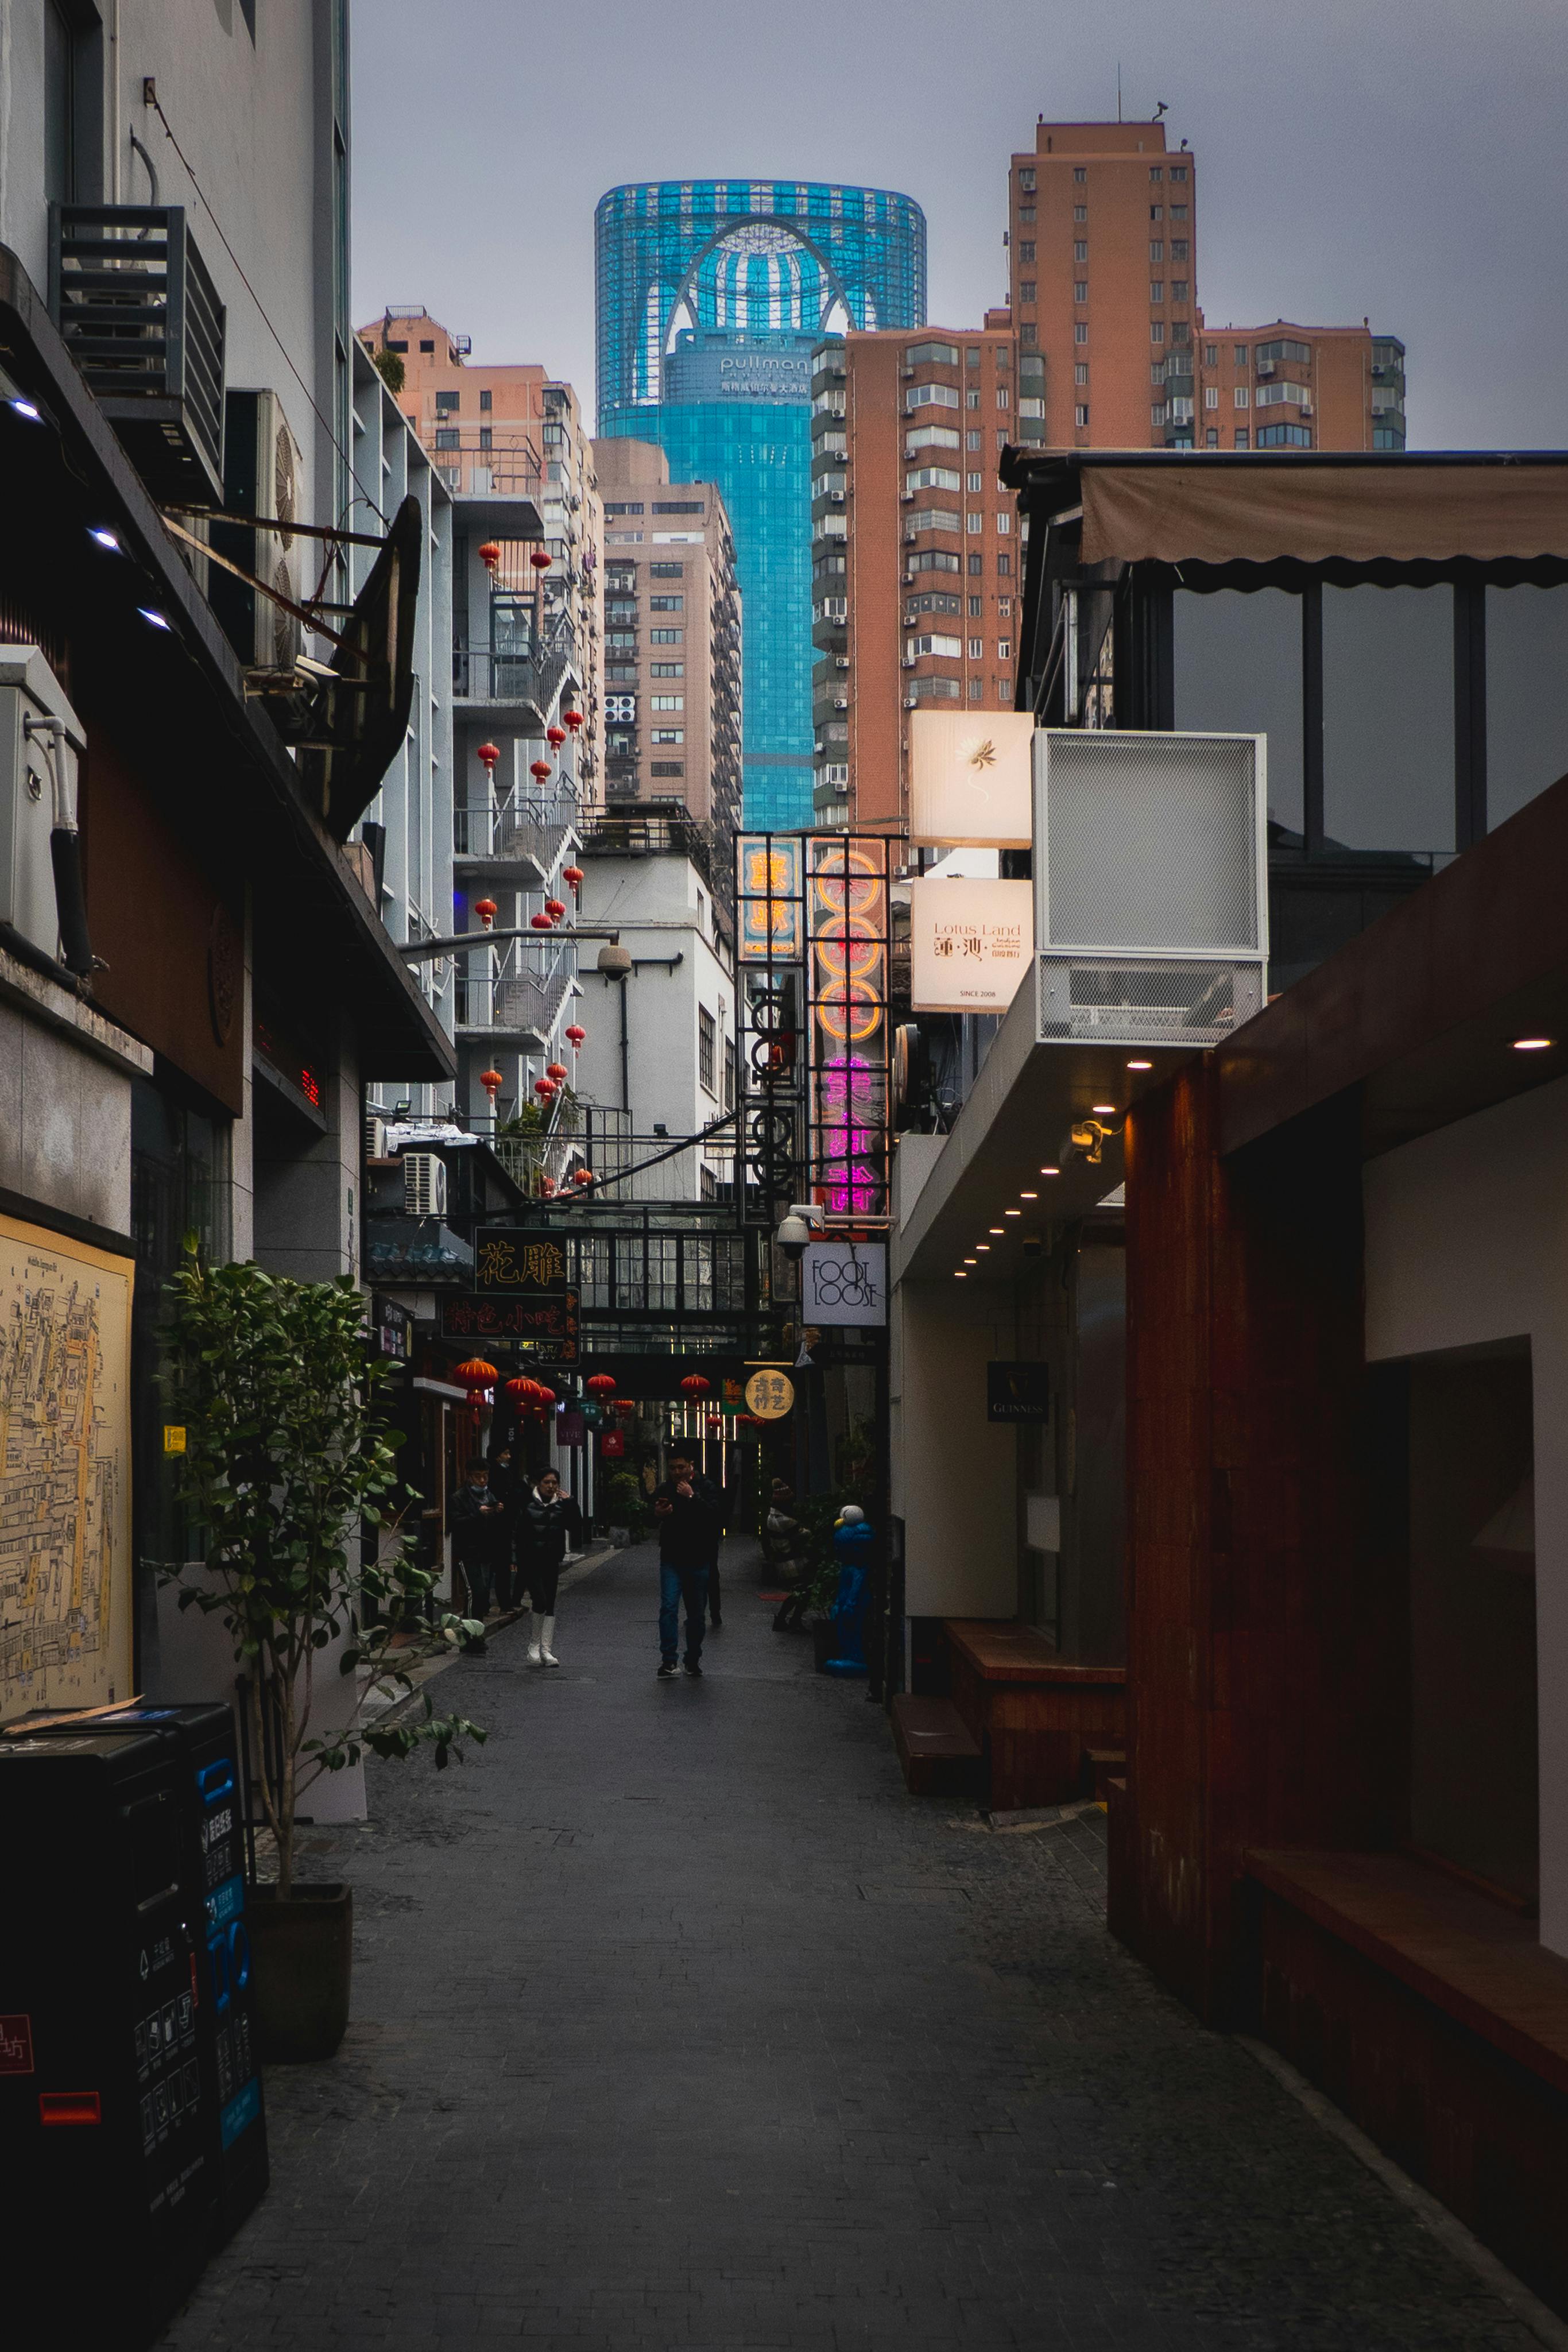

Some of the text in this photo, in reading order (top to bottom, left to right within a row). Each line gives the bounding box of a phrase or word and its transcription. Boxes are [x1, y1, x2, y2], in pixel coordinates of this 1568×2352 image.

[721, 356, 807, 374] pullman
[935, 923, 1021, 936] Lotus Land
[477, 1240, 565, 1286] 花雕
[812, 1260, 869, 1284] FOOT
[815, 1282, 877, 1307] LOOSE
[444, 1301, 565, 1333] 特色小吃
